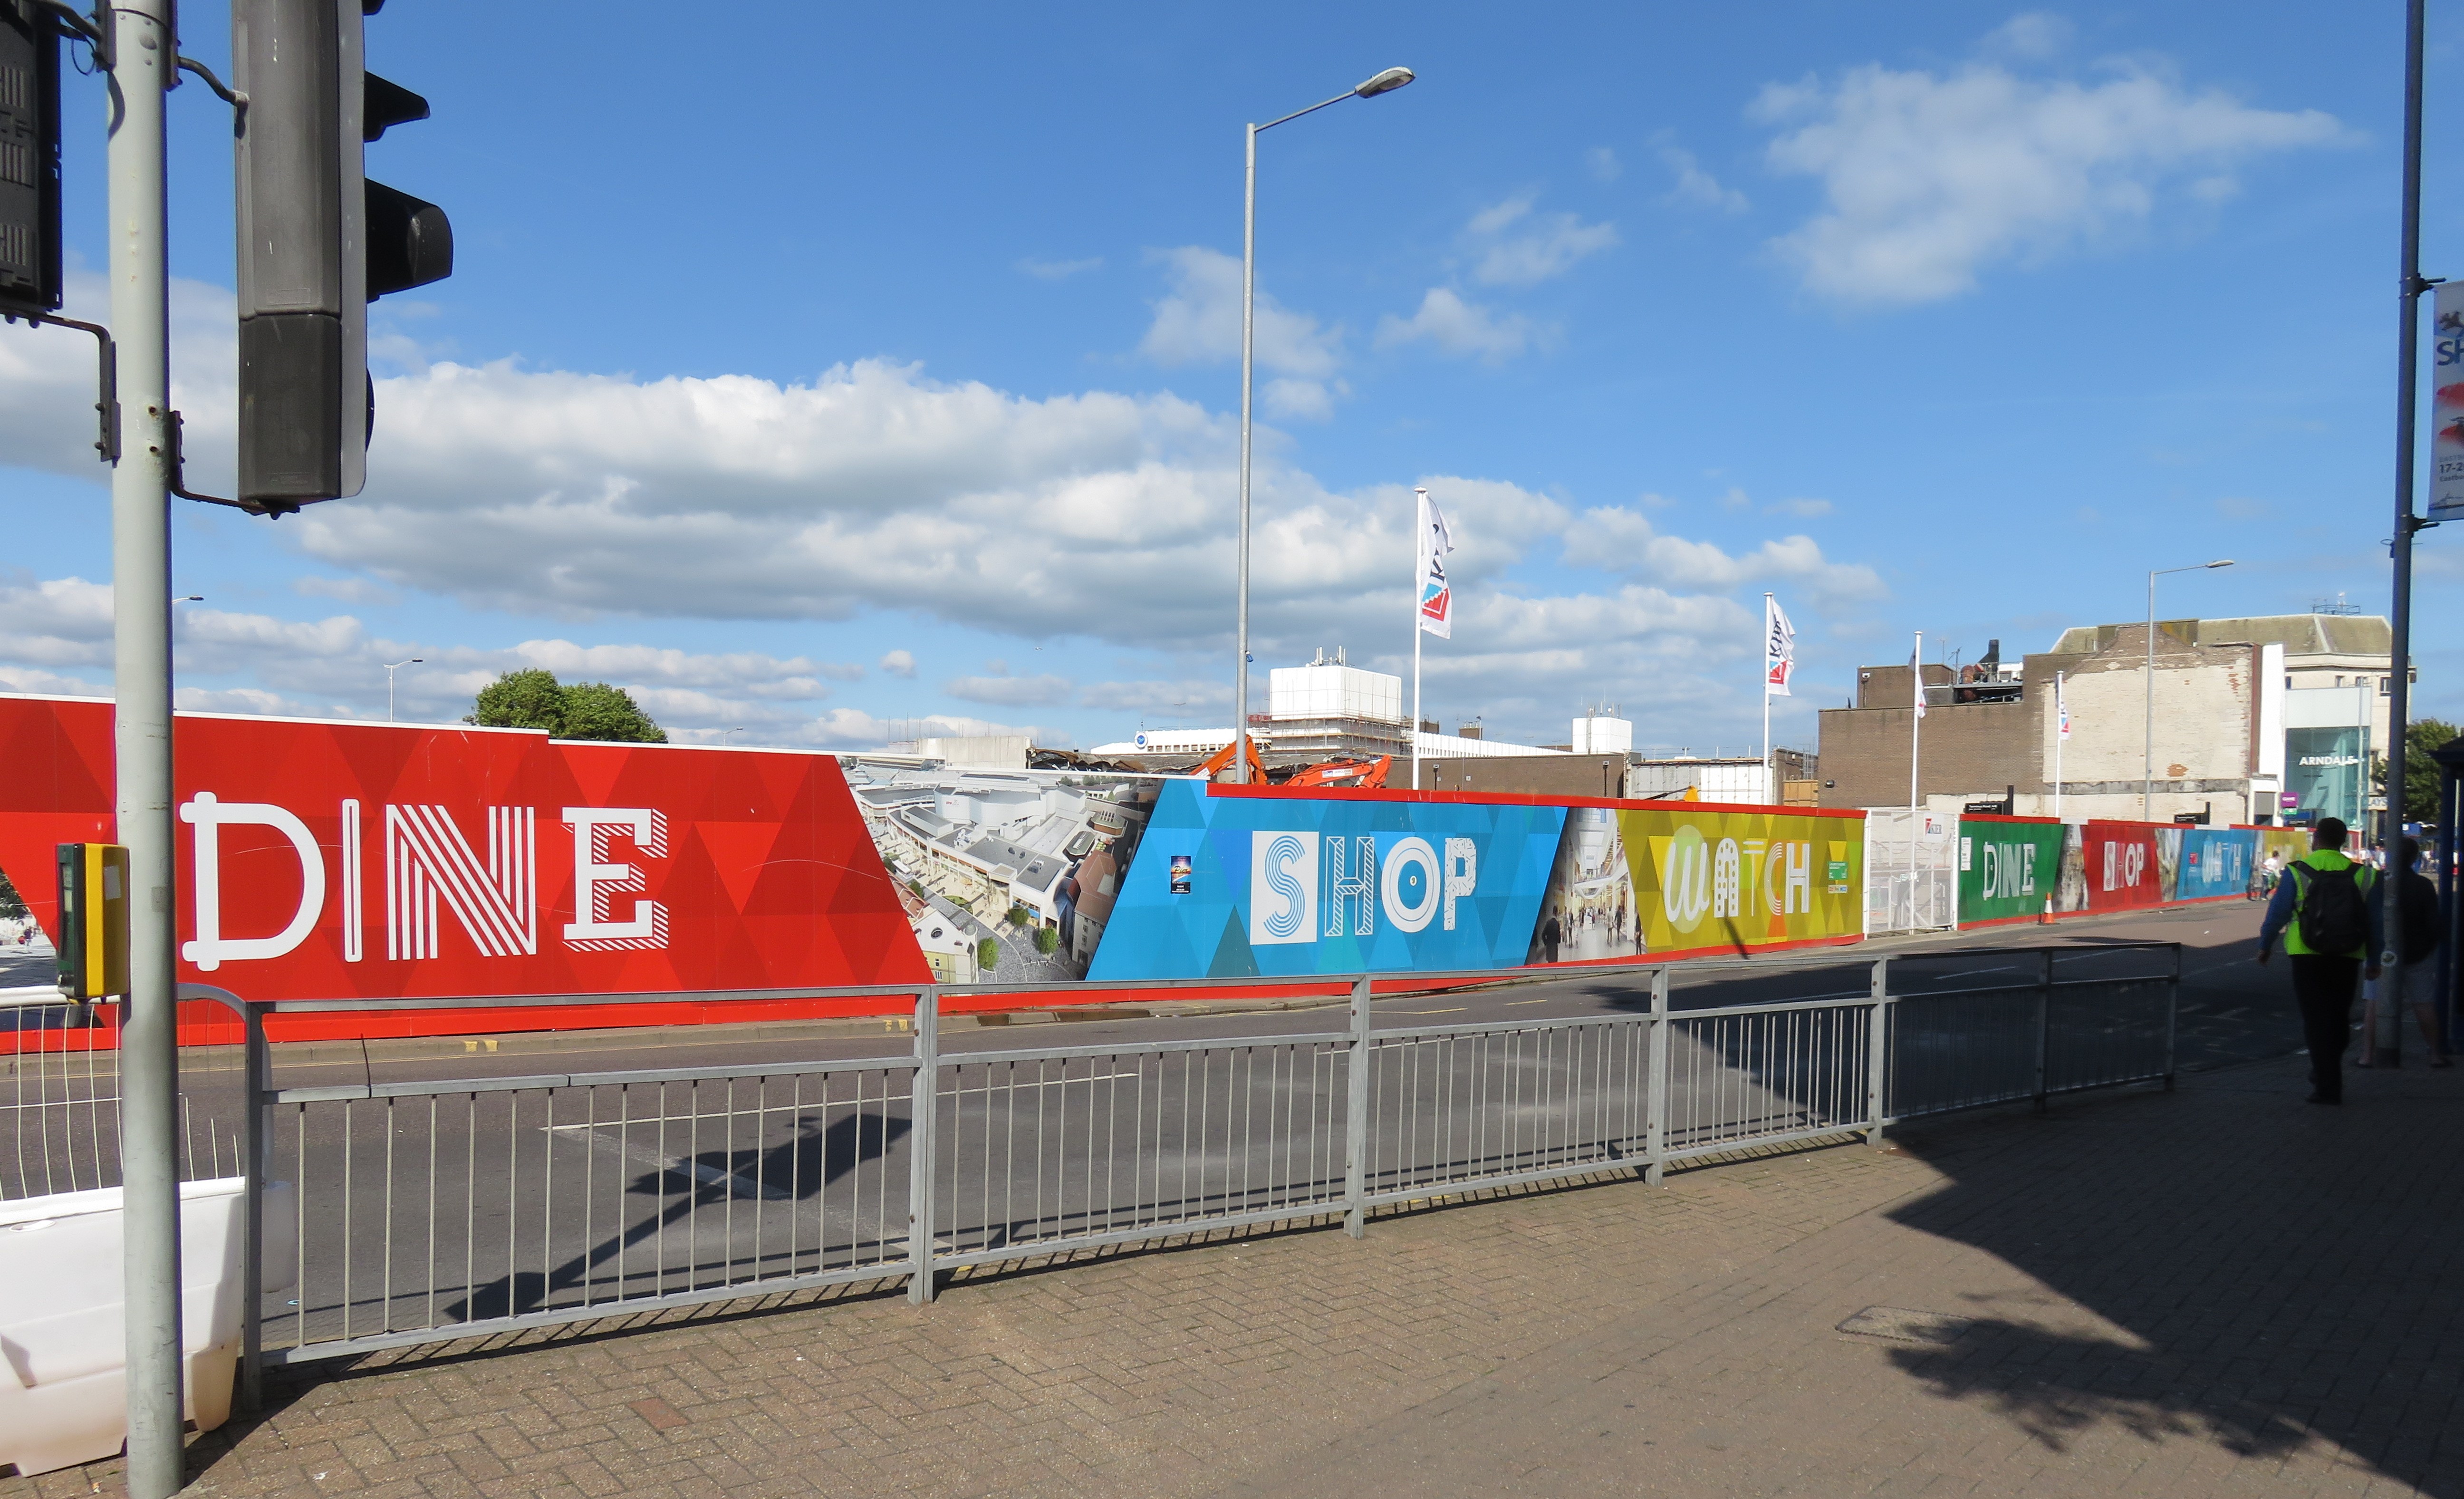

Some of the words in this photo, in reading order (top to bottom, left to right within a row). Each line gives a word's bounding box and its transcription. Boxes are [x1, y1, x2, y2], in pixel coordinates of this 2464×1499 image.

[180, 791, 668, 972] DINE
[1262, 835, 1476, 938] SHOP
[1664, 838, 1810, 922] WATCH
[1983, 841, 2036, 901] DINE
[2106, 842, 2144, 889] SHOP
